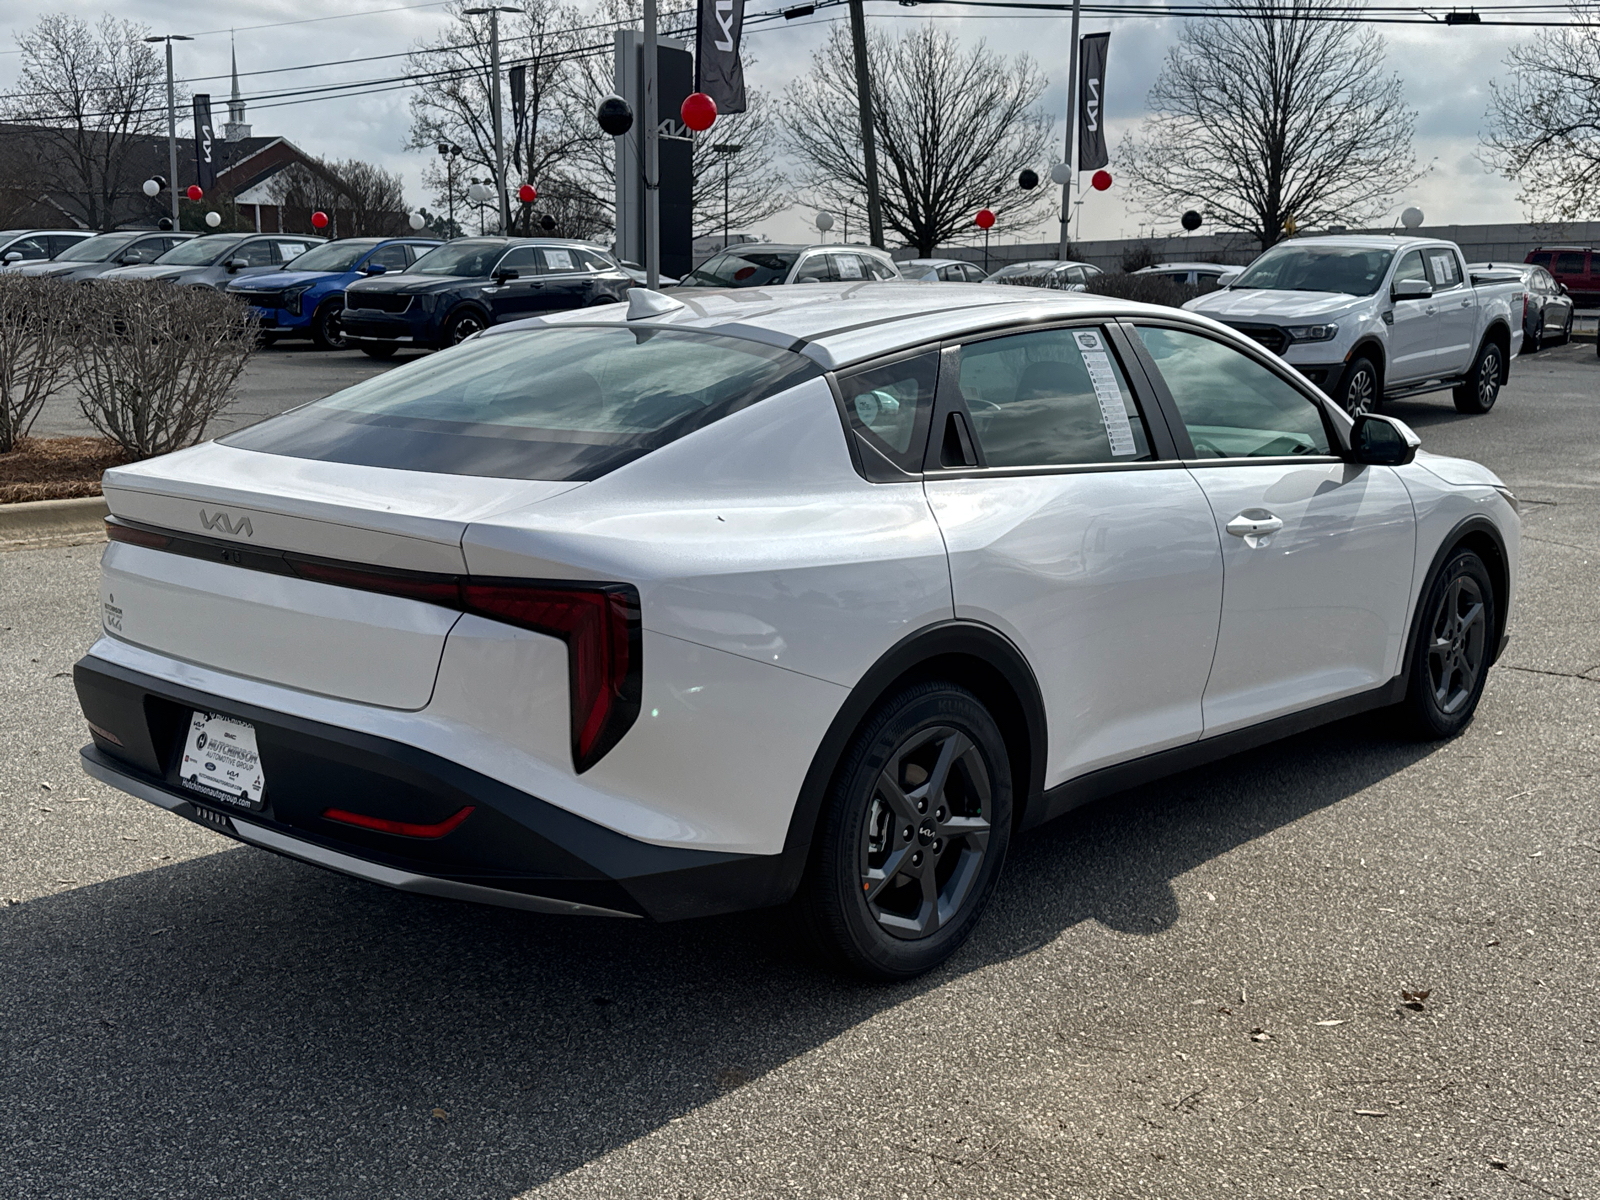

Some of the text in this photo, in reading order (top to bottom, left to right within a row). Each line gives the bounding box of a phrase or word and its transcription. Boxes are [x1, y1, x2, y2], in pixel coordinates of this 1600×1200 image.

[1087, 78, 1099, 131] KIA
[202, 125, 212, 163] KIA
[199, 508, 253, 537] KIA
[206, 751, 237, 767] AUTOMOTIVE
[236, 760, 254, 772] GROUP
[207, 739, 258, 765] HUTCHINSON
[919, 827, 936, 838] KIA
